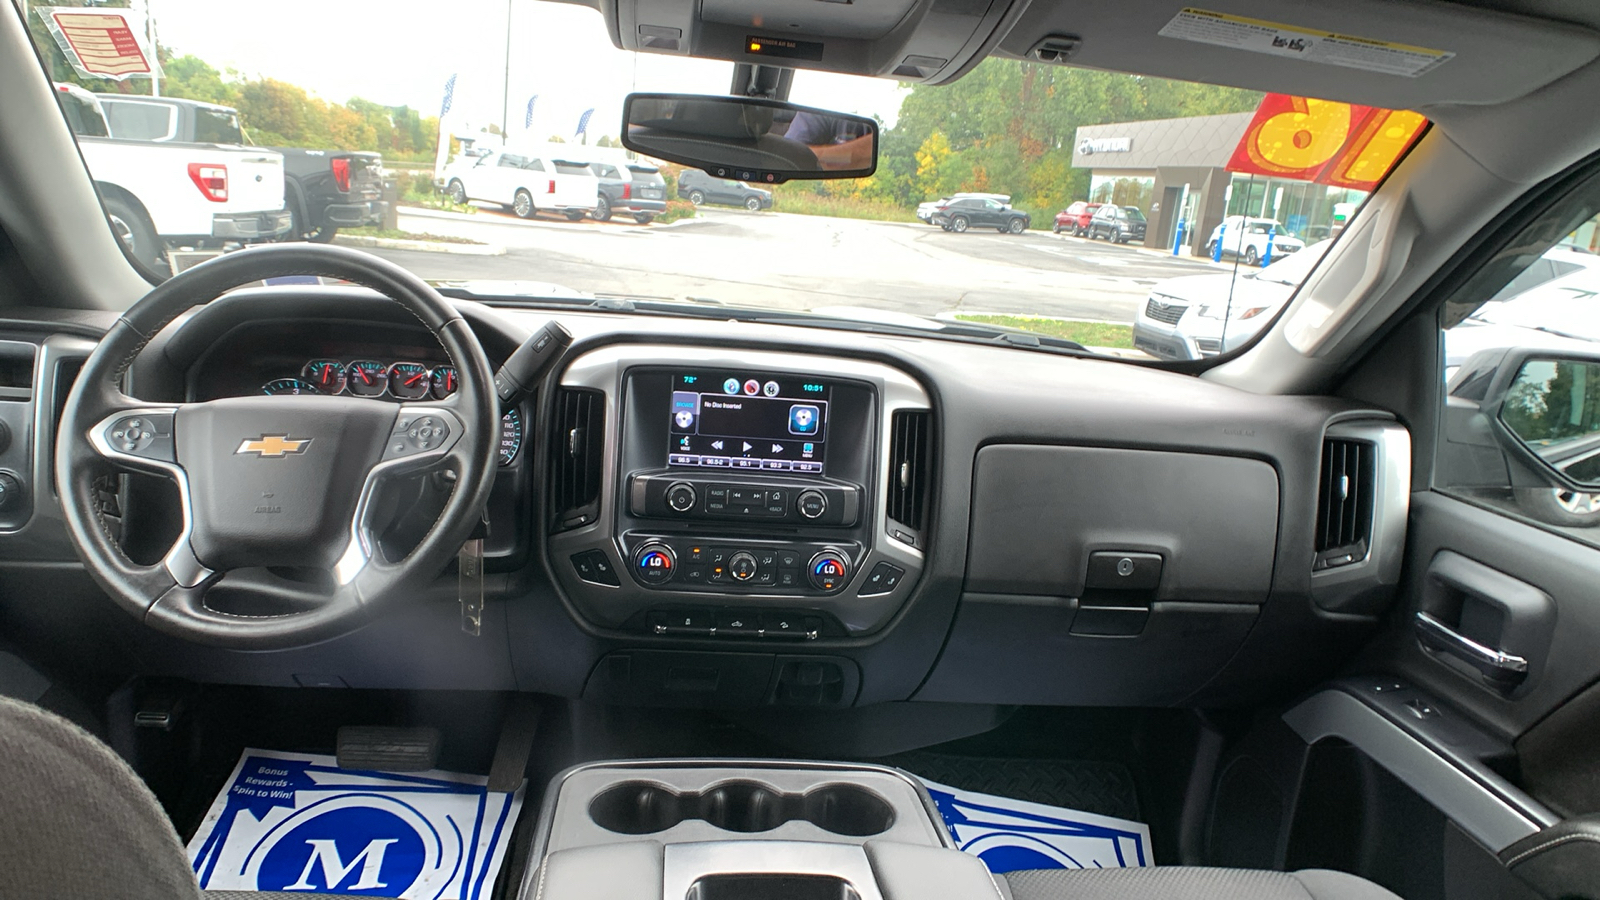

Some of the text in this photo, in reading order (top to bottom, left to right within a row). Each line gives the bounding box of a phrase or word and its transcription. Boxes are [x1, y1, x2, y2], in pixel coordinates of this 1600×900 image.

[803, 384, 823, 392] 10:51
[258, 766, 289, 776] Bonus
[245, 776, 288, 787] Rewards
[233, 785, 255, 796] Spin
[270, 790, 293, 799] Win!
[282, 838, 399, 891] M
